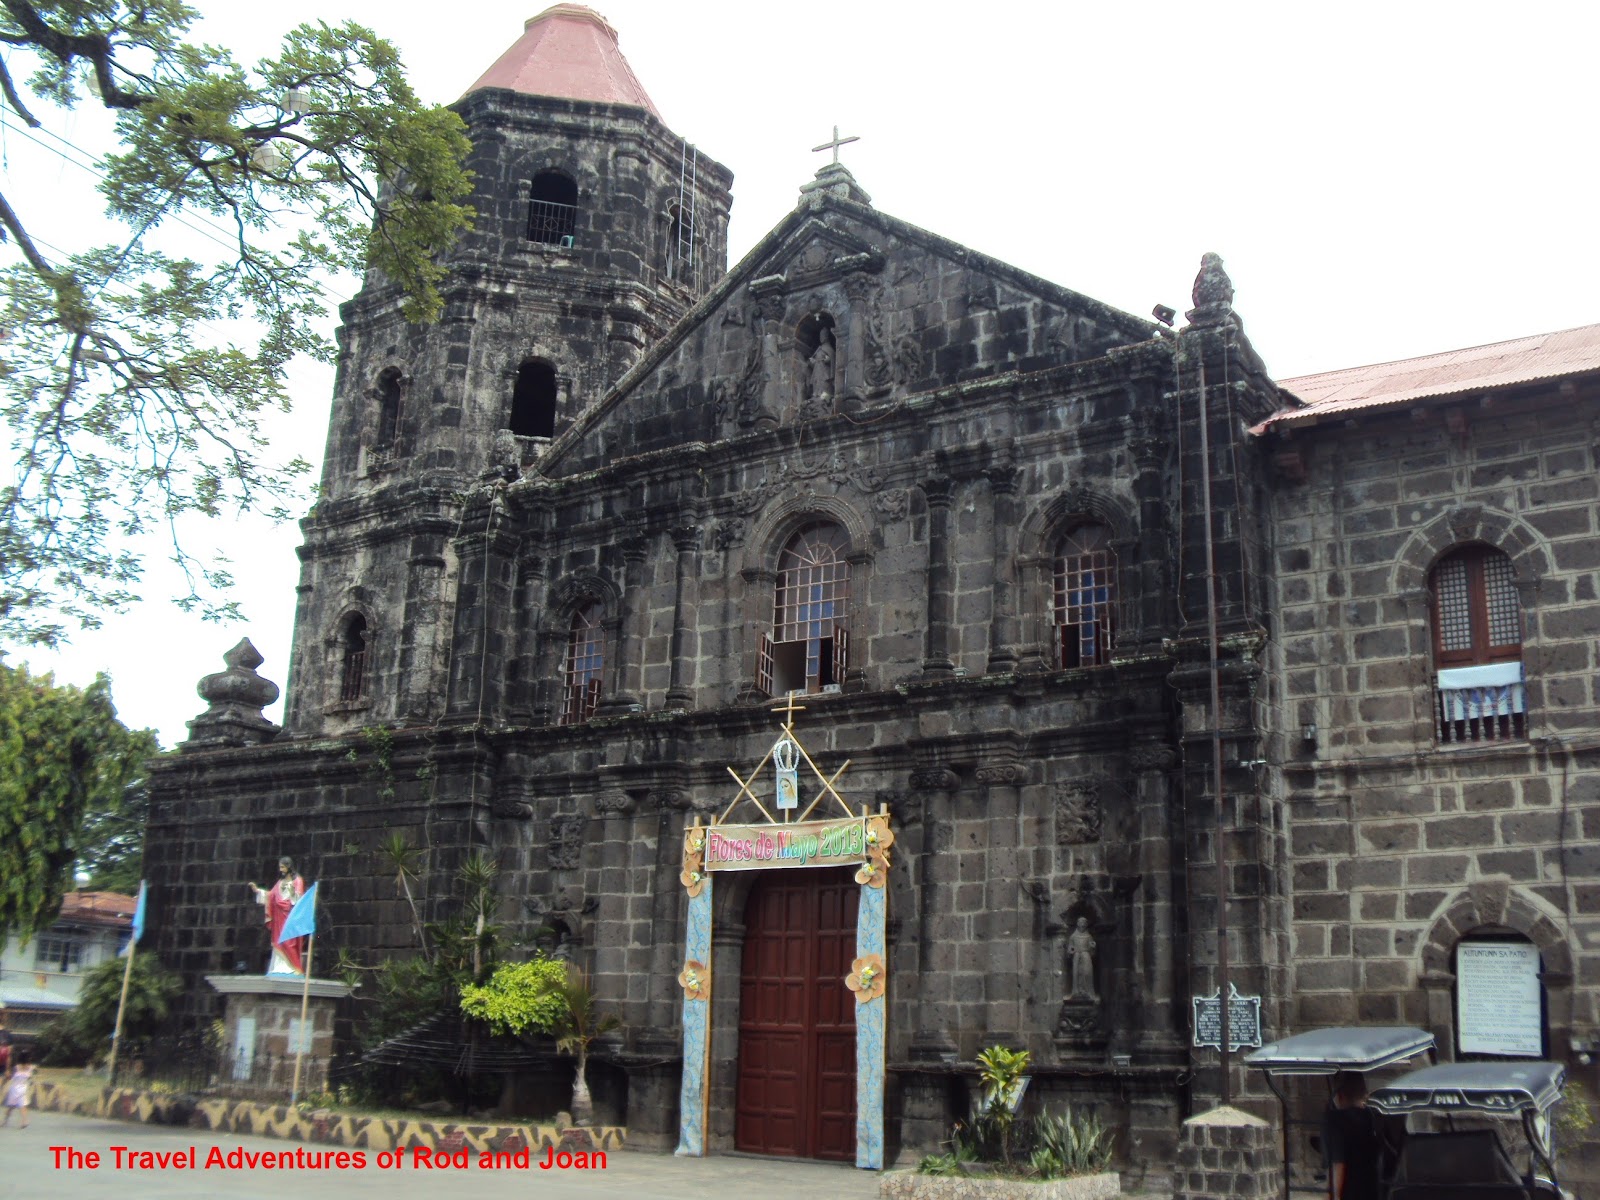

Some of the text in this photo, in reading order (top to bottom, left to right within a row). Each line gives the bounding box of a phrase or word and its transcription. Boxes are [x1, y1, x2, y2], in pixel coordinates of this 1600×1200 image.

[708, 824, 863, 865] Flores de Mayo 2013
